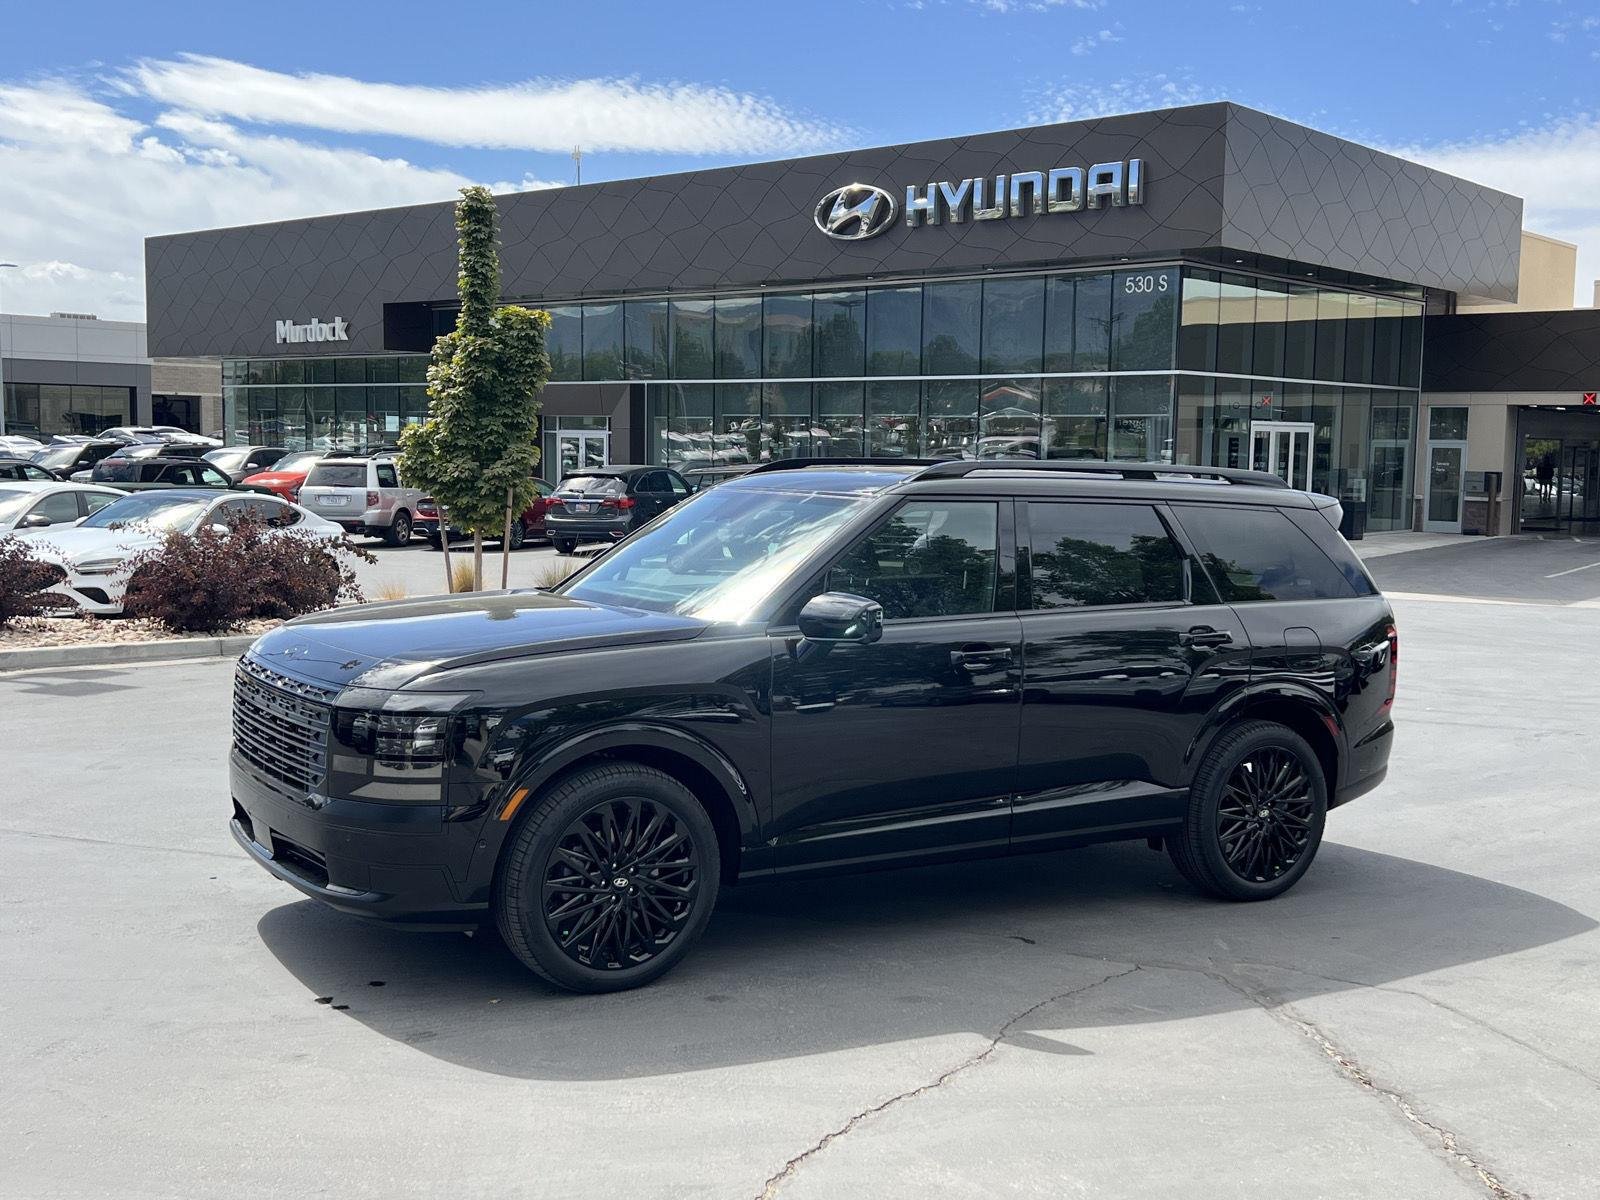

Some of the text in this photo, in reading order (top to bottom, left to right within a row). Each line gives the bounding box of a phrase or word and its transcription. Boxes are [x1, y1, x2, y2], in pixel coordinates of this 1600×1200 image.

[906, 158, 1144, 229] HYUNDAI
[1125, 274, 1168, 293] 530 S
[275, 316, 349, 344] Murdock
